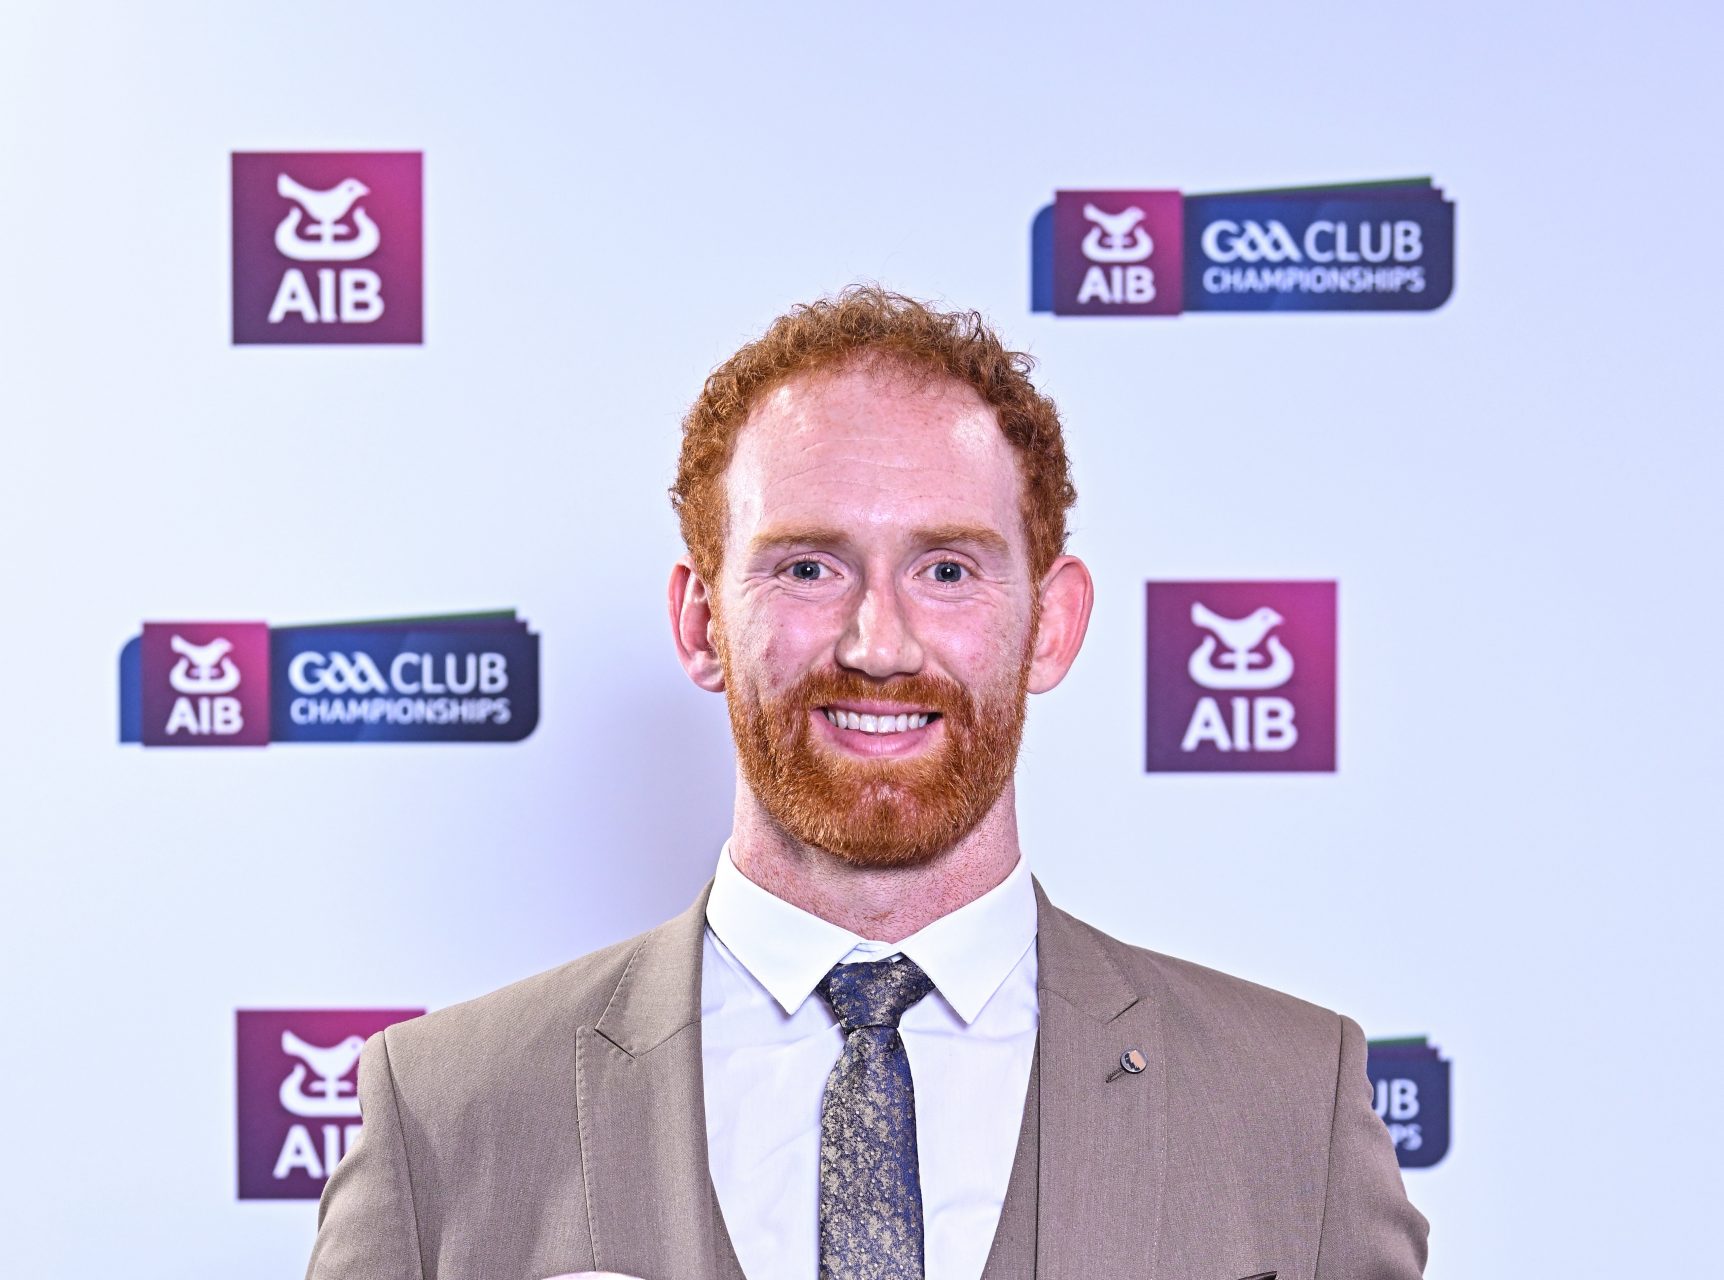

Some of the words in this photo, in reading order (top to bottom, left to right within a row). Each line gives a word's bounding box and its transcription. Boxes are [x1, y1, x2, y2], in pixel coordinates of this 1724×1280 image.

[1202, 220, 1300, 263] GAA
[1303, 221, 1423, 262] CLUB
[268, 267, 385, 323] AIB
[1077, 266, 1156, 304] AIB
[1203, 267, 1426, 294] CHAMPIONSHIPS
[289, 652, 388, 694] GAA
[390, 652, 508, 694] CLUB
[165, 697, 244, 735] AIB
[290, 698, 511, 725] CHAMPIONSHIPS
[1181, 697, 1298, 751] AIB
[1374, 1078, 1420, 1121] UB
[272, 1124, 363, 1179] AI
